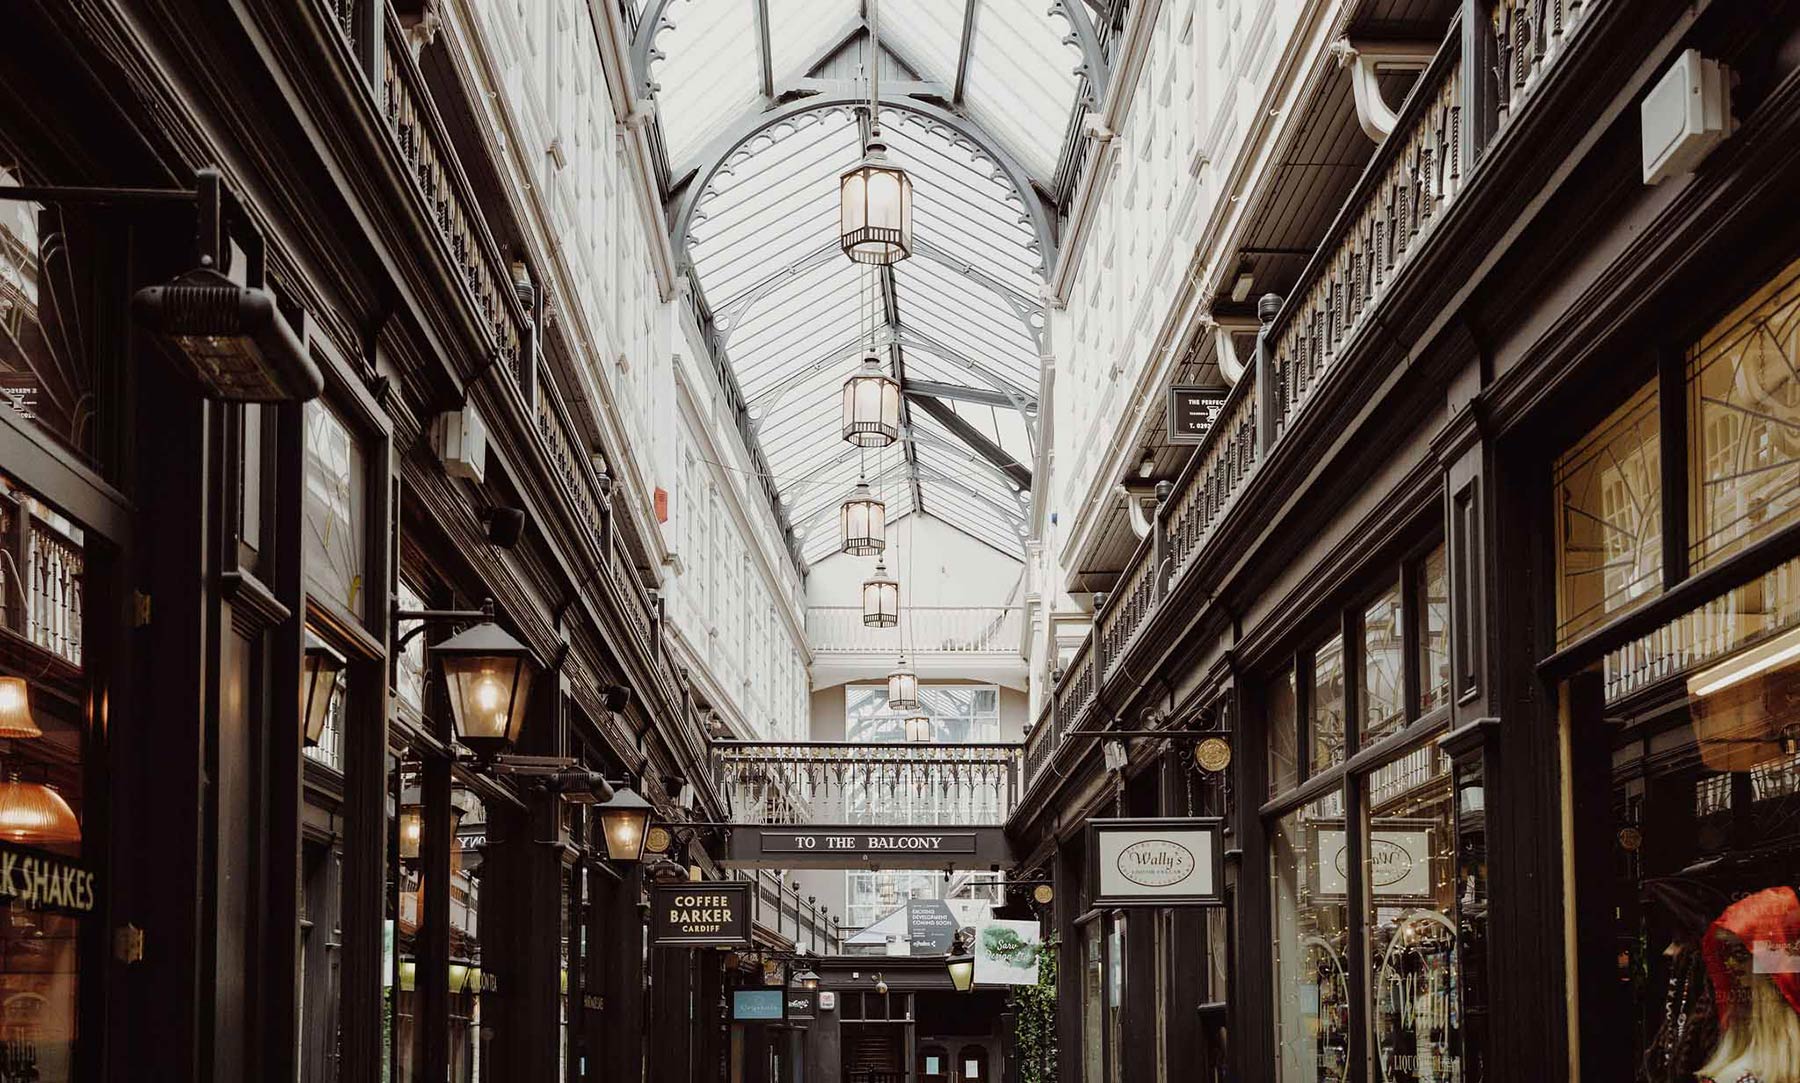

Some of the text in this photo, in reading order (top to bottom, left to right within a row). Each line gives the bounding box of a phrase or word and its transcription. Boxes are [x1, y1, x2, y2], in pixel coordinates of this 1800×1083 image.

[795, 836, 942, 849] TO THE BALCONY
[1129, 851, 1183, 871] Wally's
[22, 855, 94, 911] SHAKES
[674, 896, 728, 907] COFFEE
[669, 909, 733, 923] BARKER
[682, 925, 720, 933] CARDIFF
